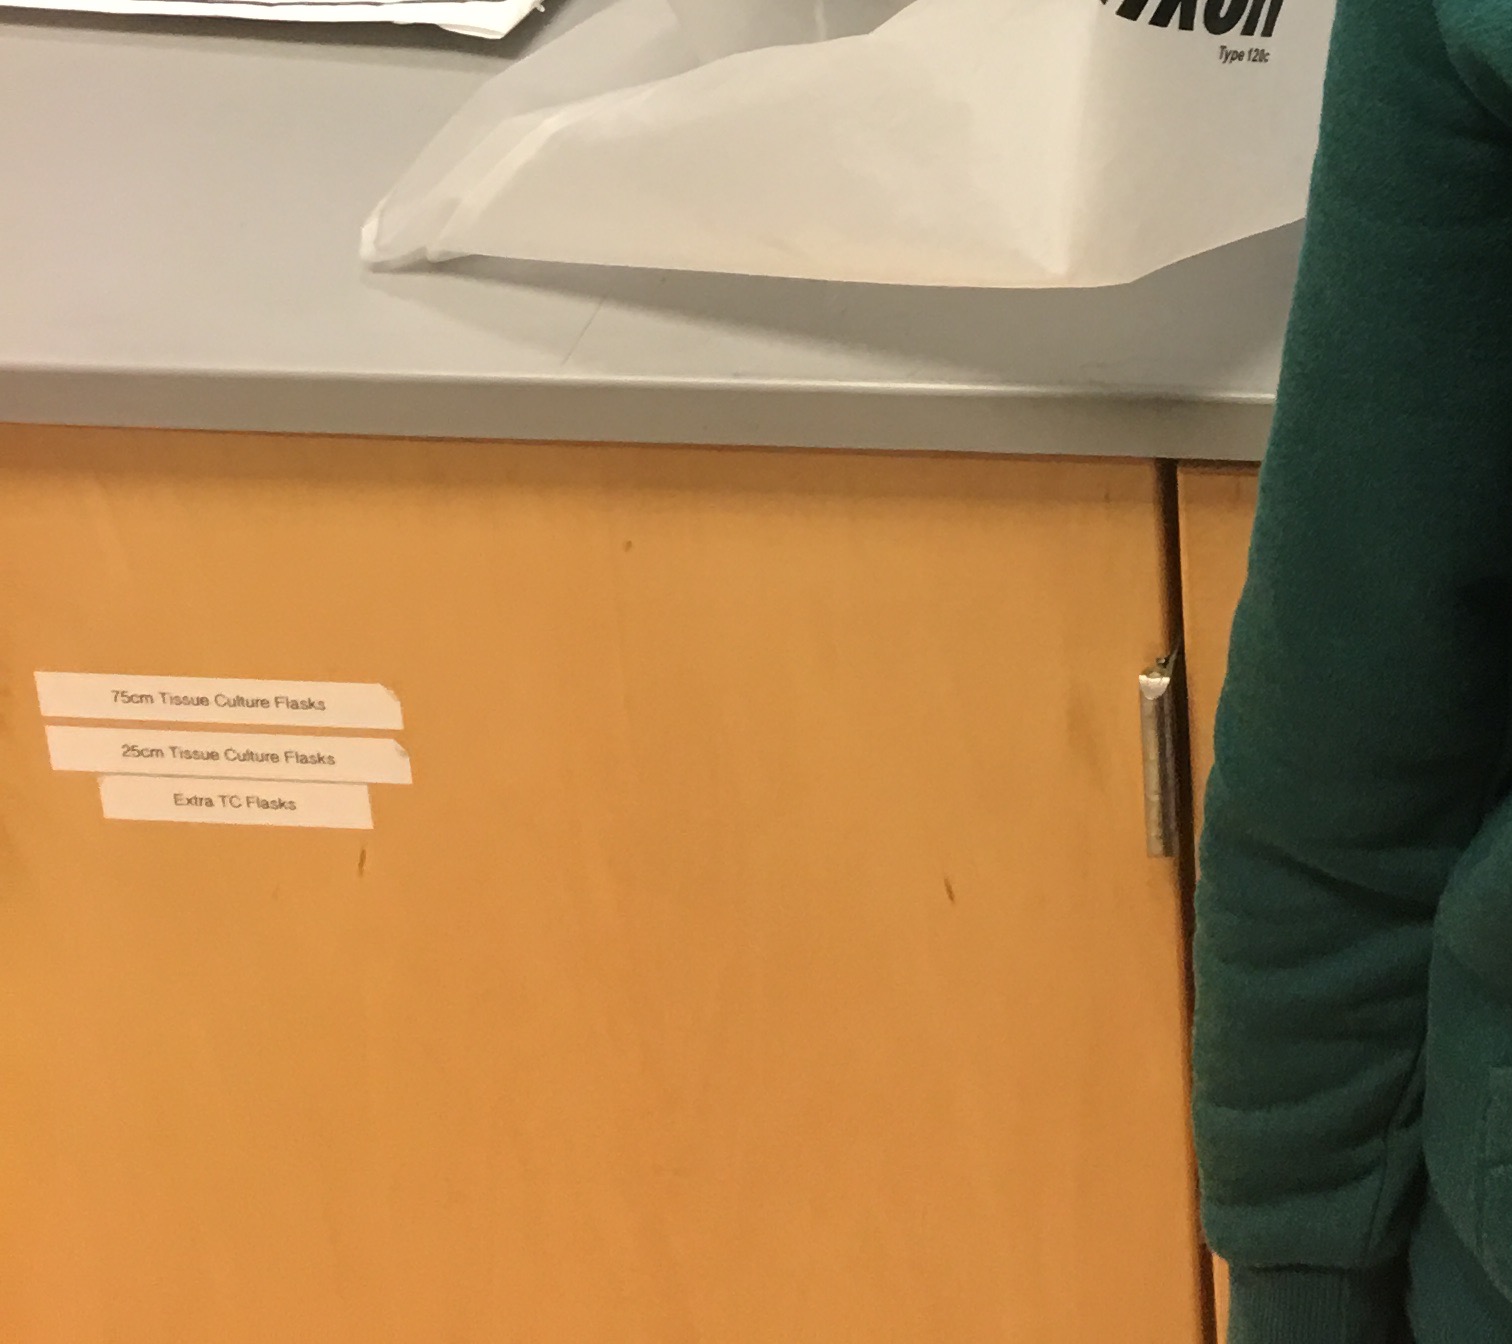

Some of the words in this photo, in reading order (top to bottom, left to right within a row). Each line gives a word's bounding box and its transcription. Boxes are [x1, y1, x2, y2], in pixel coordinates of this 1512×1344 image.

[1218, 44, 1245, 64] Type
[110, 689, 155, 705] 75cm
[159, 691, 210, 708] Tissue
[213, 693, 271, 710] Culture
[274, 694, 327, 712] Flasks
[120, 743, 164, 760] 25cm
[168, 745, 220, 762] Tissue
[223, 747, 280, 764] Culture
[283, 749, 337, 766] Flasks
[173, 793, 215, 809] Extra
[217, 794, 243, 810] TC
[246, 795, 297, 812] Flasks
